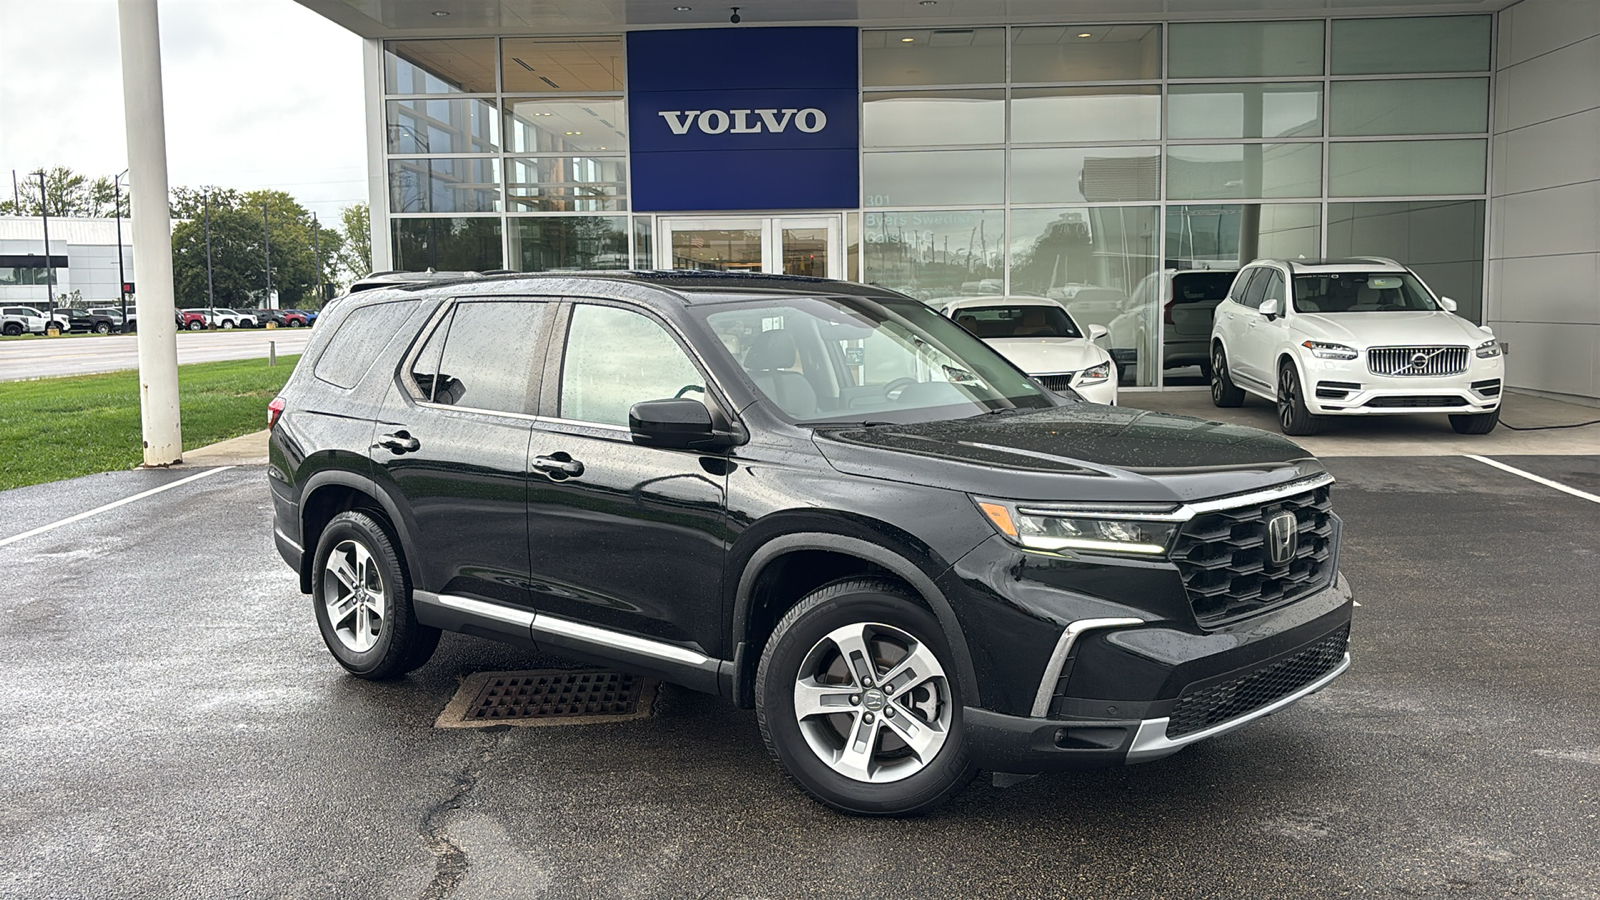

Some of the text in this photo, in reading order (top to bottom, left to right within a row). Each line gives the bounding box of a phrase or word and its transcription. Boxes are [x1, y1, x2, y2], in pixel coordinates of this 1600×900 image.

[658, 108, 827, 135] VOLVO
[866, 194, 890, 206] 301
[866, 214, 907, 228] Byers
